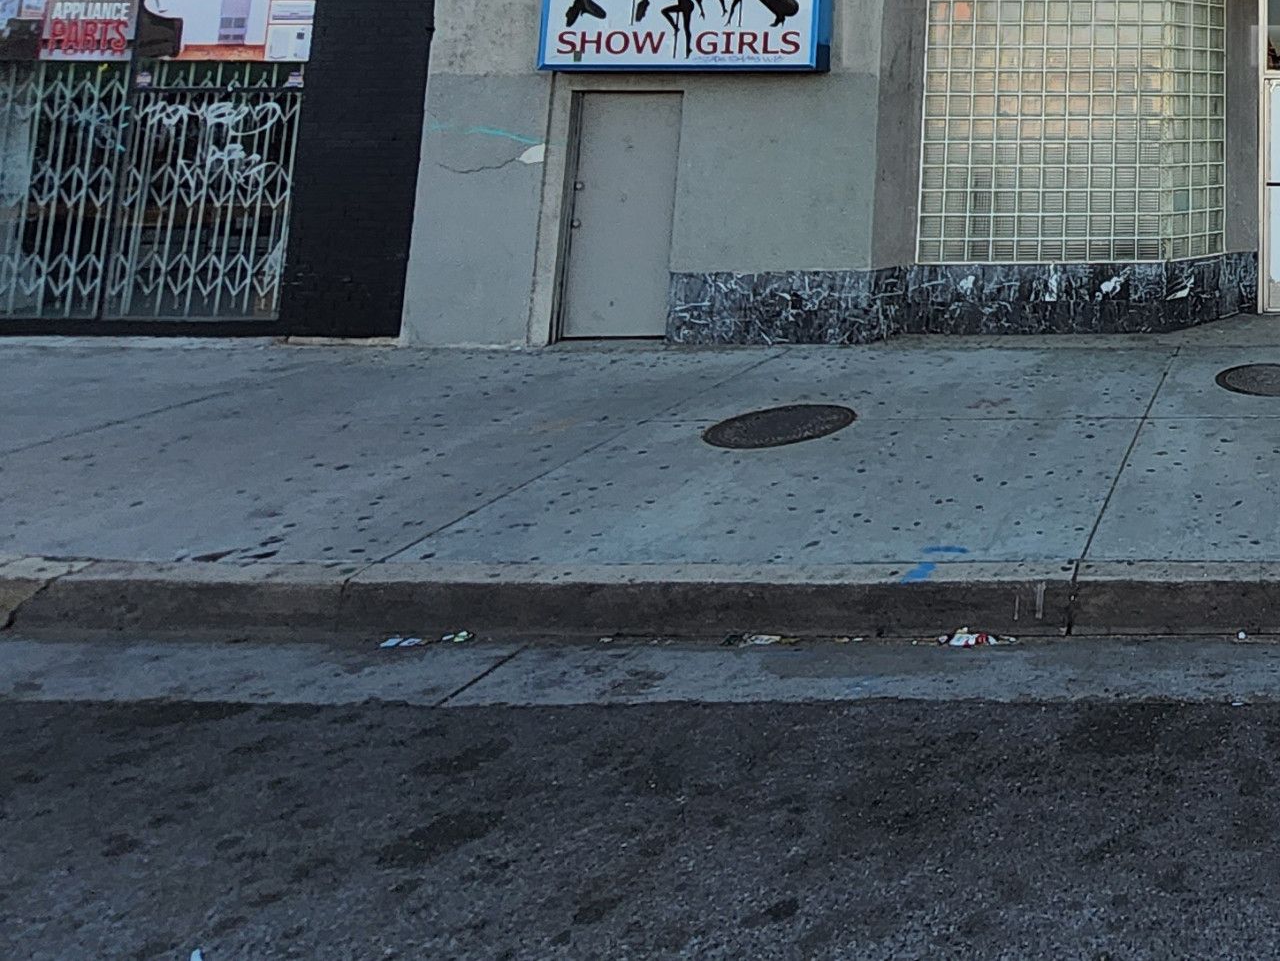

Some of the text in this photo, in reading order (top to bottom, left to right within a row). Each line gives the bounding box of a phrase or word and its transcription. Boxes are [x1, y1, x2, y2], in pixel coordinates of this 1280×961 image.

[51, 2, 130, 20] APPLIANCE
[50, 19, 129, 51] PARTS
[556, 31, 800, 55] SHOW GIRLS
